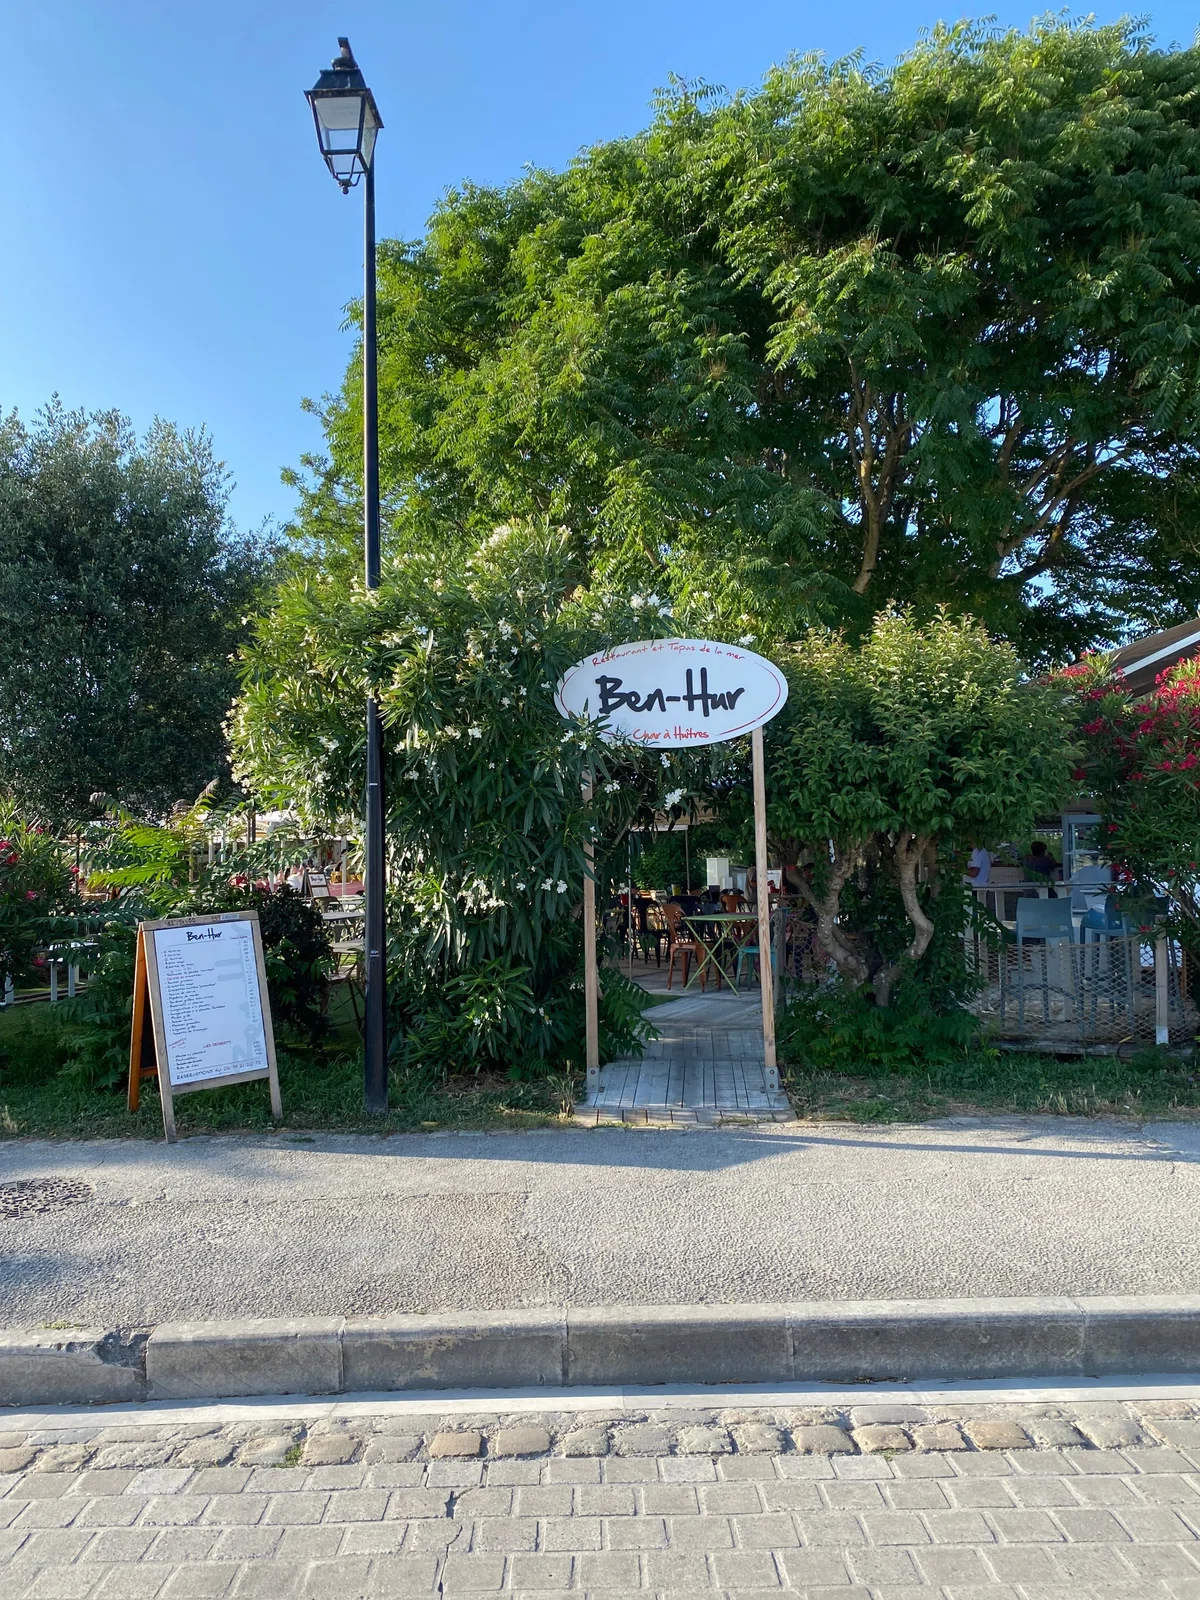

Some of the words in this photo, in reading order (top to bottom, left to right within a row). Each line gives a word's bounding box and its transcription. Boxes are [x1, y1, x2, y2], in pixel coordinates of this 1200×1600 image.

[591, 645, 648, 667] Restaurant
[652, 643, 664, 652] et
[668, 642, 696, 655] Tapas
[699, 643, 711, 653] de
[714, 645, 723, 655] la
[726, 651, 746, 660] mer
[594, 666, 746, 718] Ben-Hur
[632, 728, 662, 741] Char
[663, 728, 671, 740] à
[673, 725, 710, 741] Huîtres
[186, 927, 223, 942] Ben-Hur
